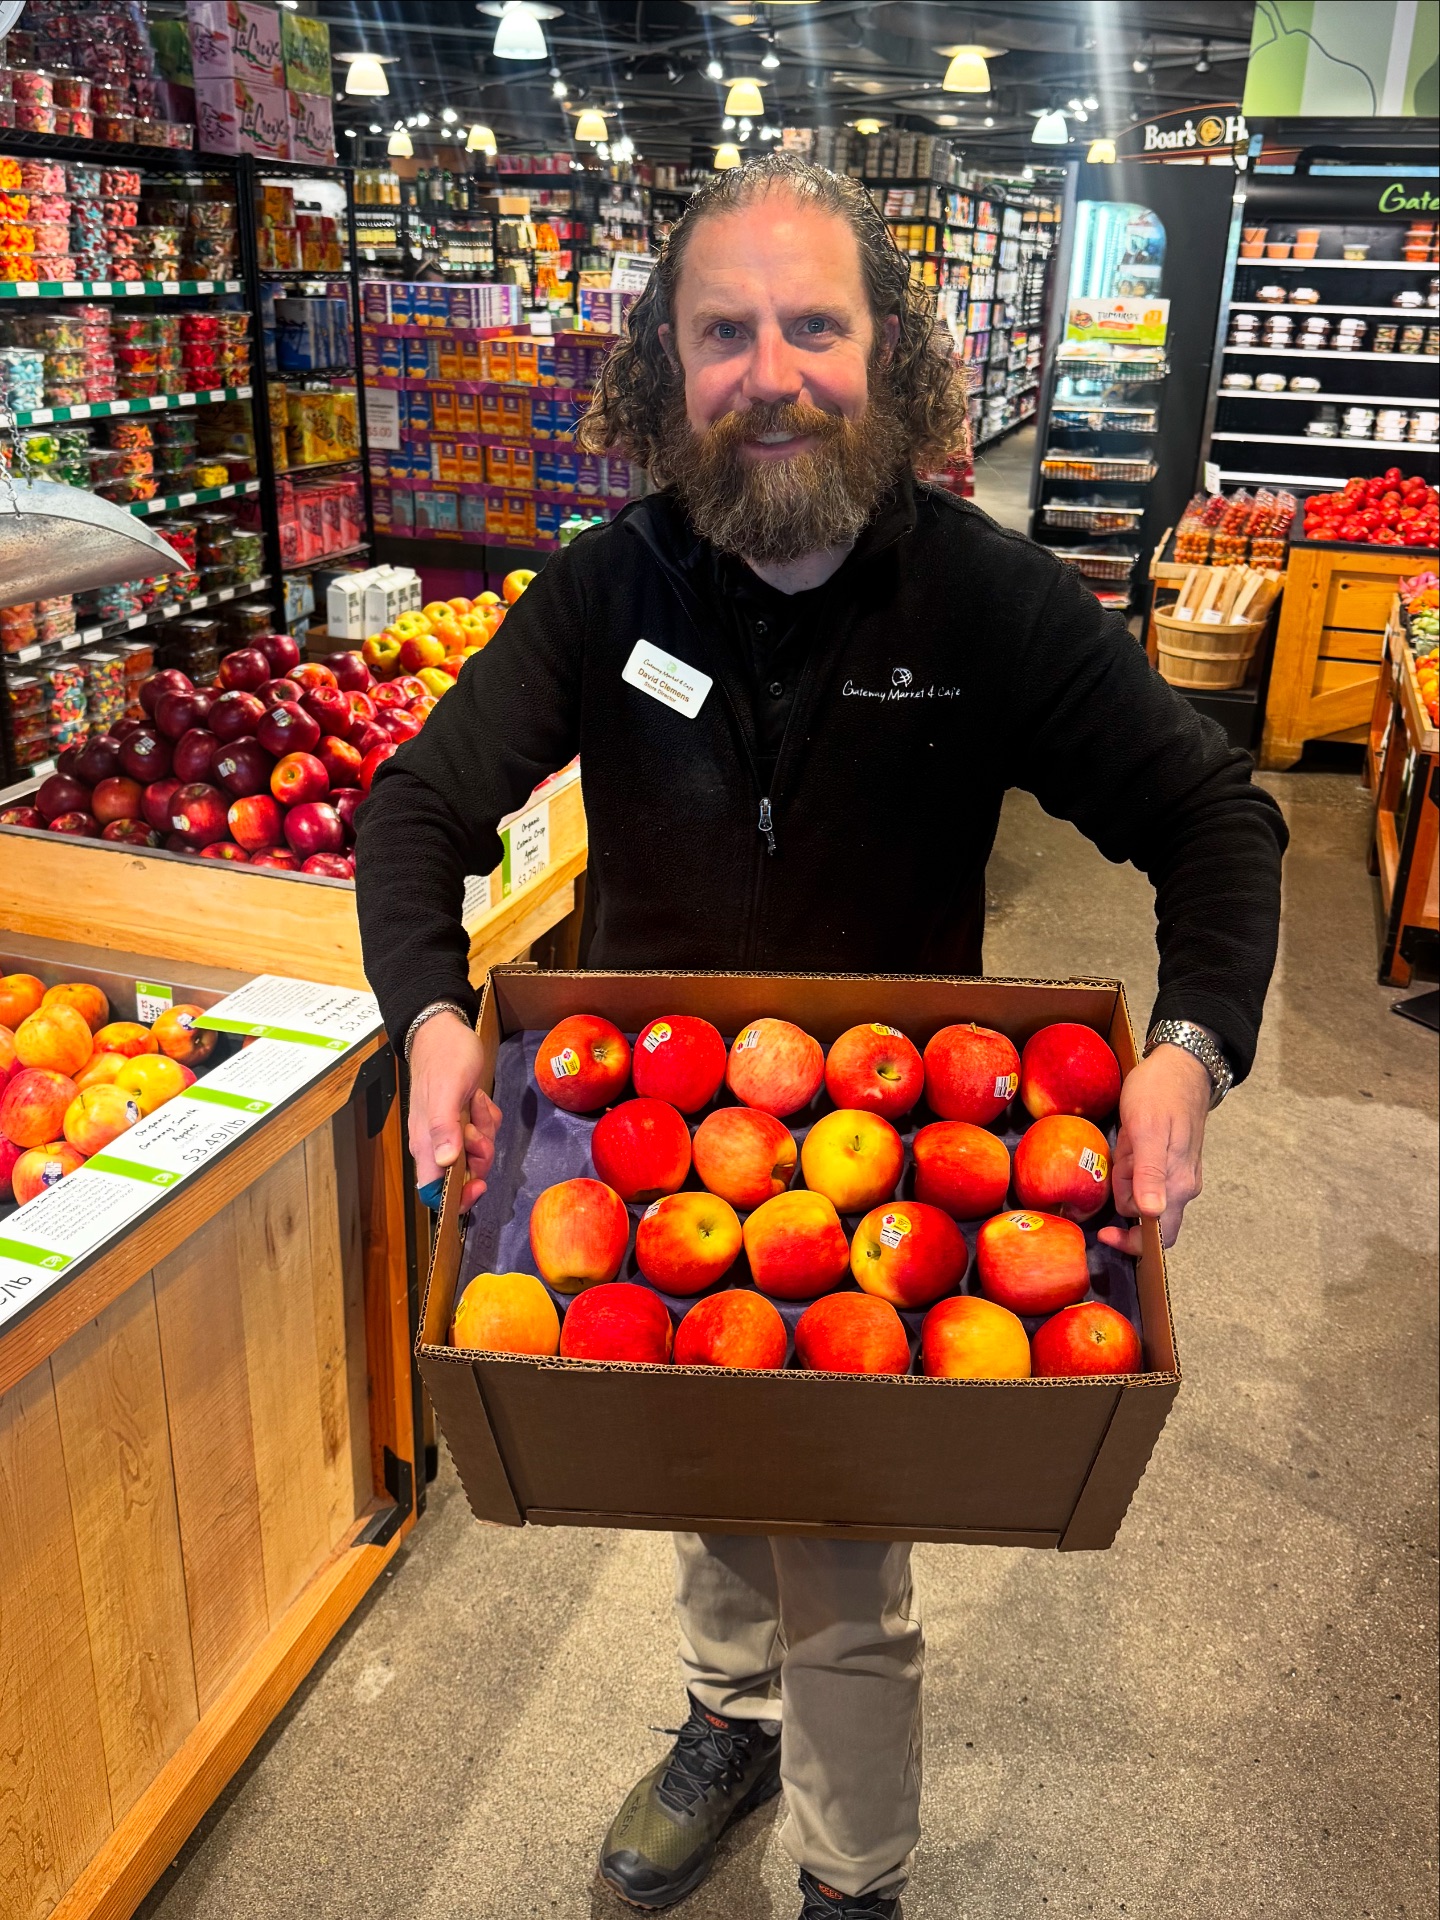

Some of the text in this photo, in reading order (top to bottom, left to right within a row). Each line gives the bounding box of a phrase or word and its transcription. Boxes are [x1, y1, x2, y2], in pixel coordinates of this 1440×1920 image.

[1144, 115, 1249, 150] Boar's H
[637, 668, 690, 703] David Clemens
[644, 681, 677, 703] Store Director
[843, 680, 886, 703] Gateway
[887, 688, 924, 701] Market
[521, 816, 540, 833] Organic
[305, 998, 337, 1017] Organic
[335, 996, 360, 1012] Apples
[135, 1114, 171, 1137] Organic
[139, 1109, 199, 1150] Granny Smith
[172, 1123, 199, 1142] Apples
[182, 1119, 247, 1162] $3.49/lb
[620, 1794, 641, 1836] KEEN
